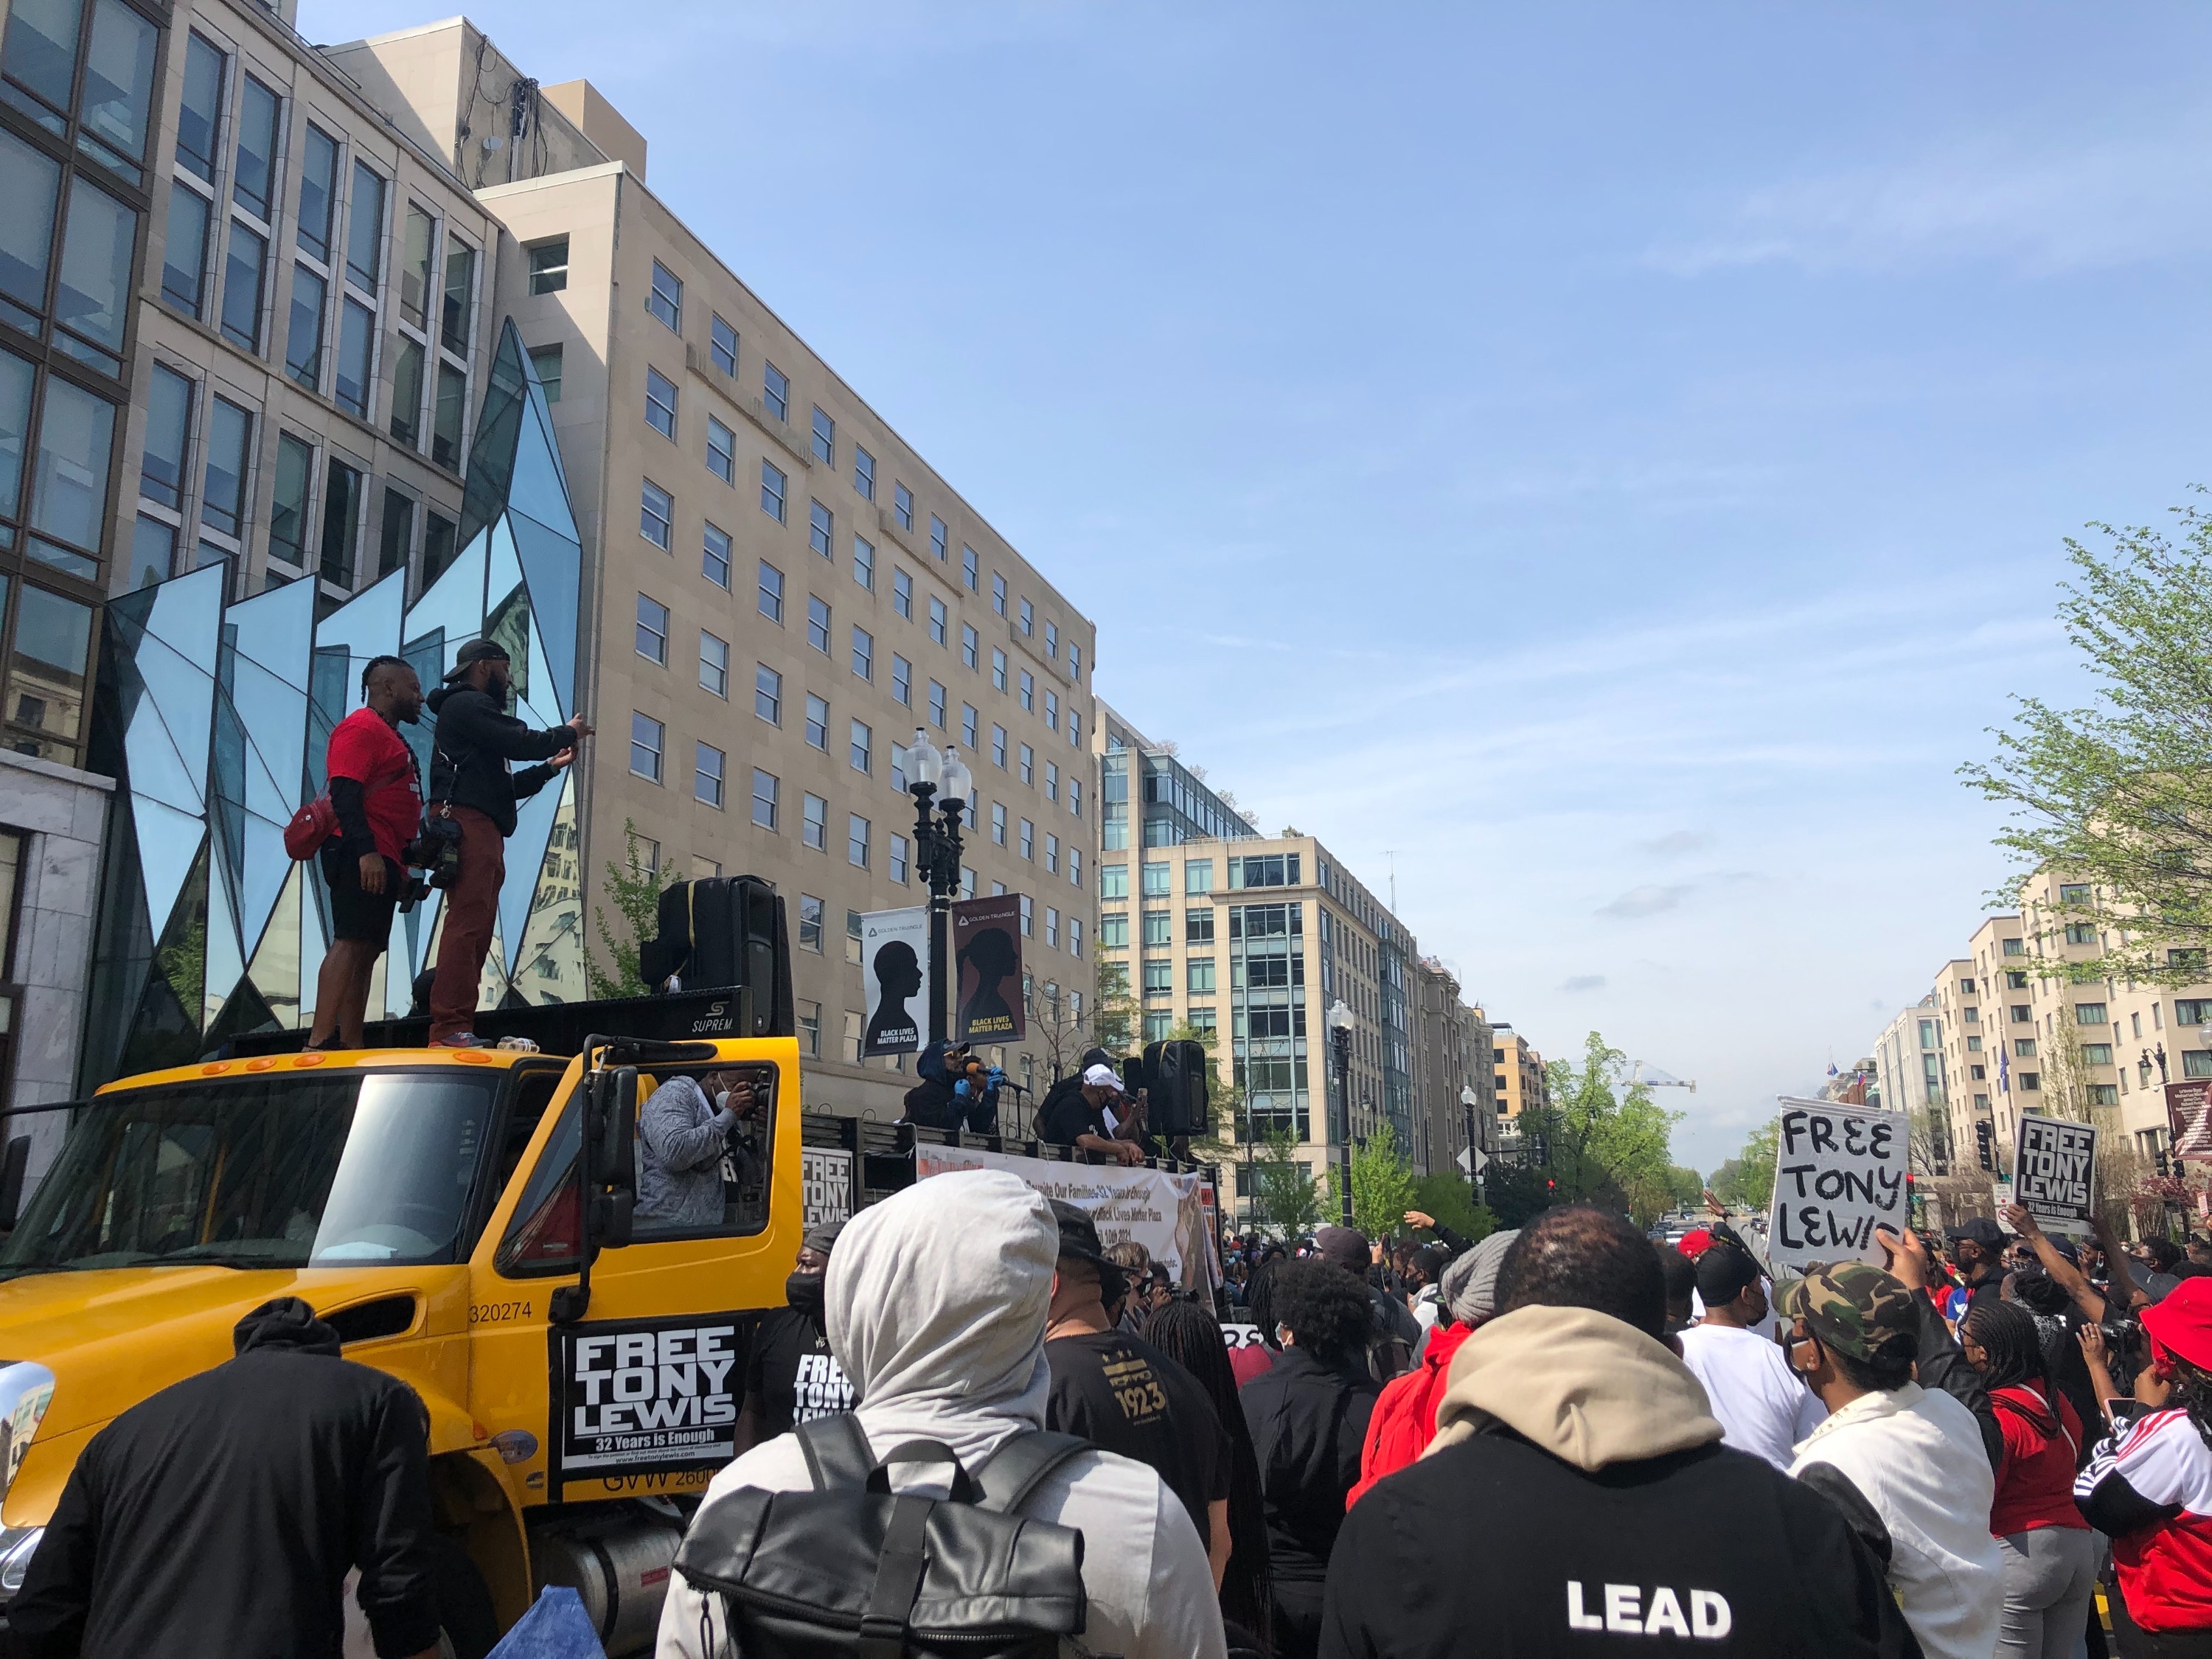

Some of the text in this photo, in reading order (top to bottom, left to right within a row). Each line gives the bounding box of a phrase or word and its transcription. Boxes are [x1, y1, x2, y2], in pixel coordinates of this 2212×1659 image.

[968, 911, 1015, 922] GOLDEN TRIANGLE
[692, 1018, 733, 1032] SUPREM
[880, 1027, 914, 1037] BLACK LIVES
[968, 1022, 1013, 1034] MATTER PLAZA
[972, 1015, 1009, 1026] BLACK LIVES
[877, 1034, 917, 1045] MATTER PLAZA
[1782, 1110, 1893, 1159] FREE
[2024, 1121, 2092, 1157] FREE
[801, 1153, 849, 1183] FREE
[2023, 1147, 2090, 1182] TONY
[801, 1180, 849, 1208] TONY
[1054, 1181, 1068, 1198] Our
[1782, 1164, 1902, 1211] TONY
[2020, 1174, 2087, 1205] LEWIS
[1113, 1206, 1130, 1221] Lives
[1131, 1207, 1147, 1221] Matter
[1148, 1207, 1162, 1222] Plaza
[2027, 1201, 2035, 1212] 32
[2035, 1202, 2051, 1214] Years
[2051, 1204, 2056, 1215] is
[1118, 1228, 1131, 1242] 2021
[469, 1301, 532, 1324] 320274
[576, 1326, 735, 1372] FREE
[575, 1359, 736, 1405] TONY
[793, 1381, 855, 1409] TONY
[1114, 1381, 1166, 1419] 1923
[574, 1393, 736, 1436] LEWIS
[596, 1428, 714, 1452] 32 Years is Enough
[616, 1451, 695, 1464] www.freetonylewis.com
[1568, 1580, 1732, 1639] LEAD
